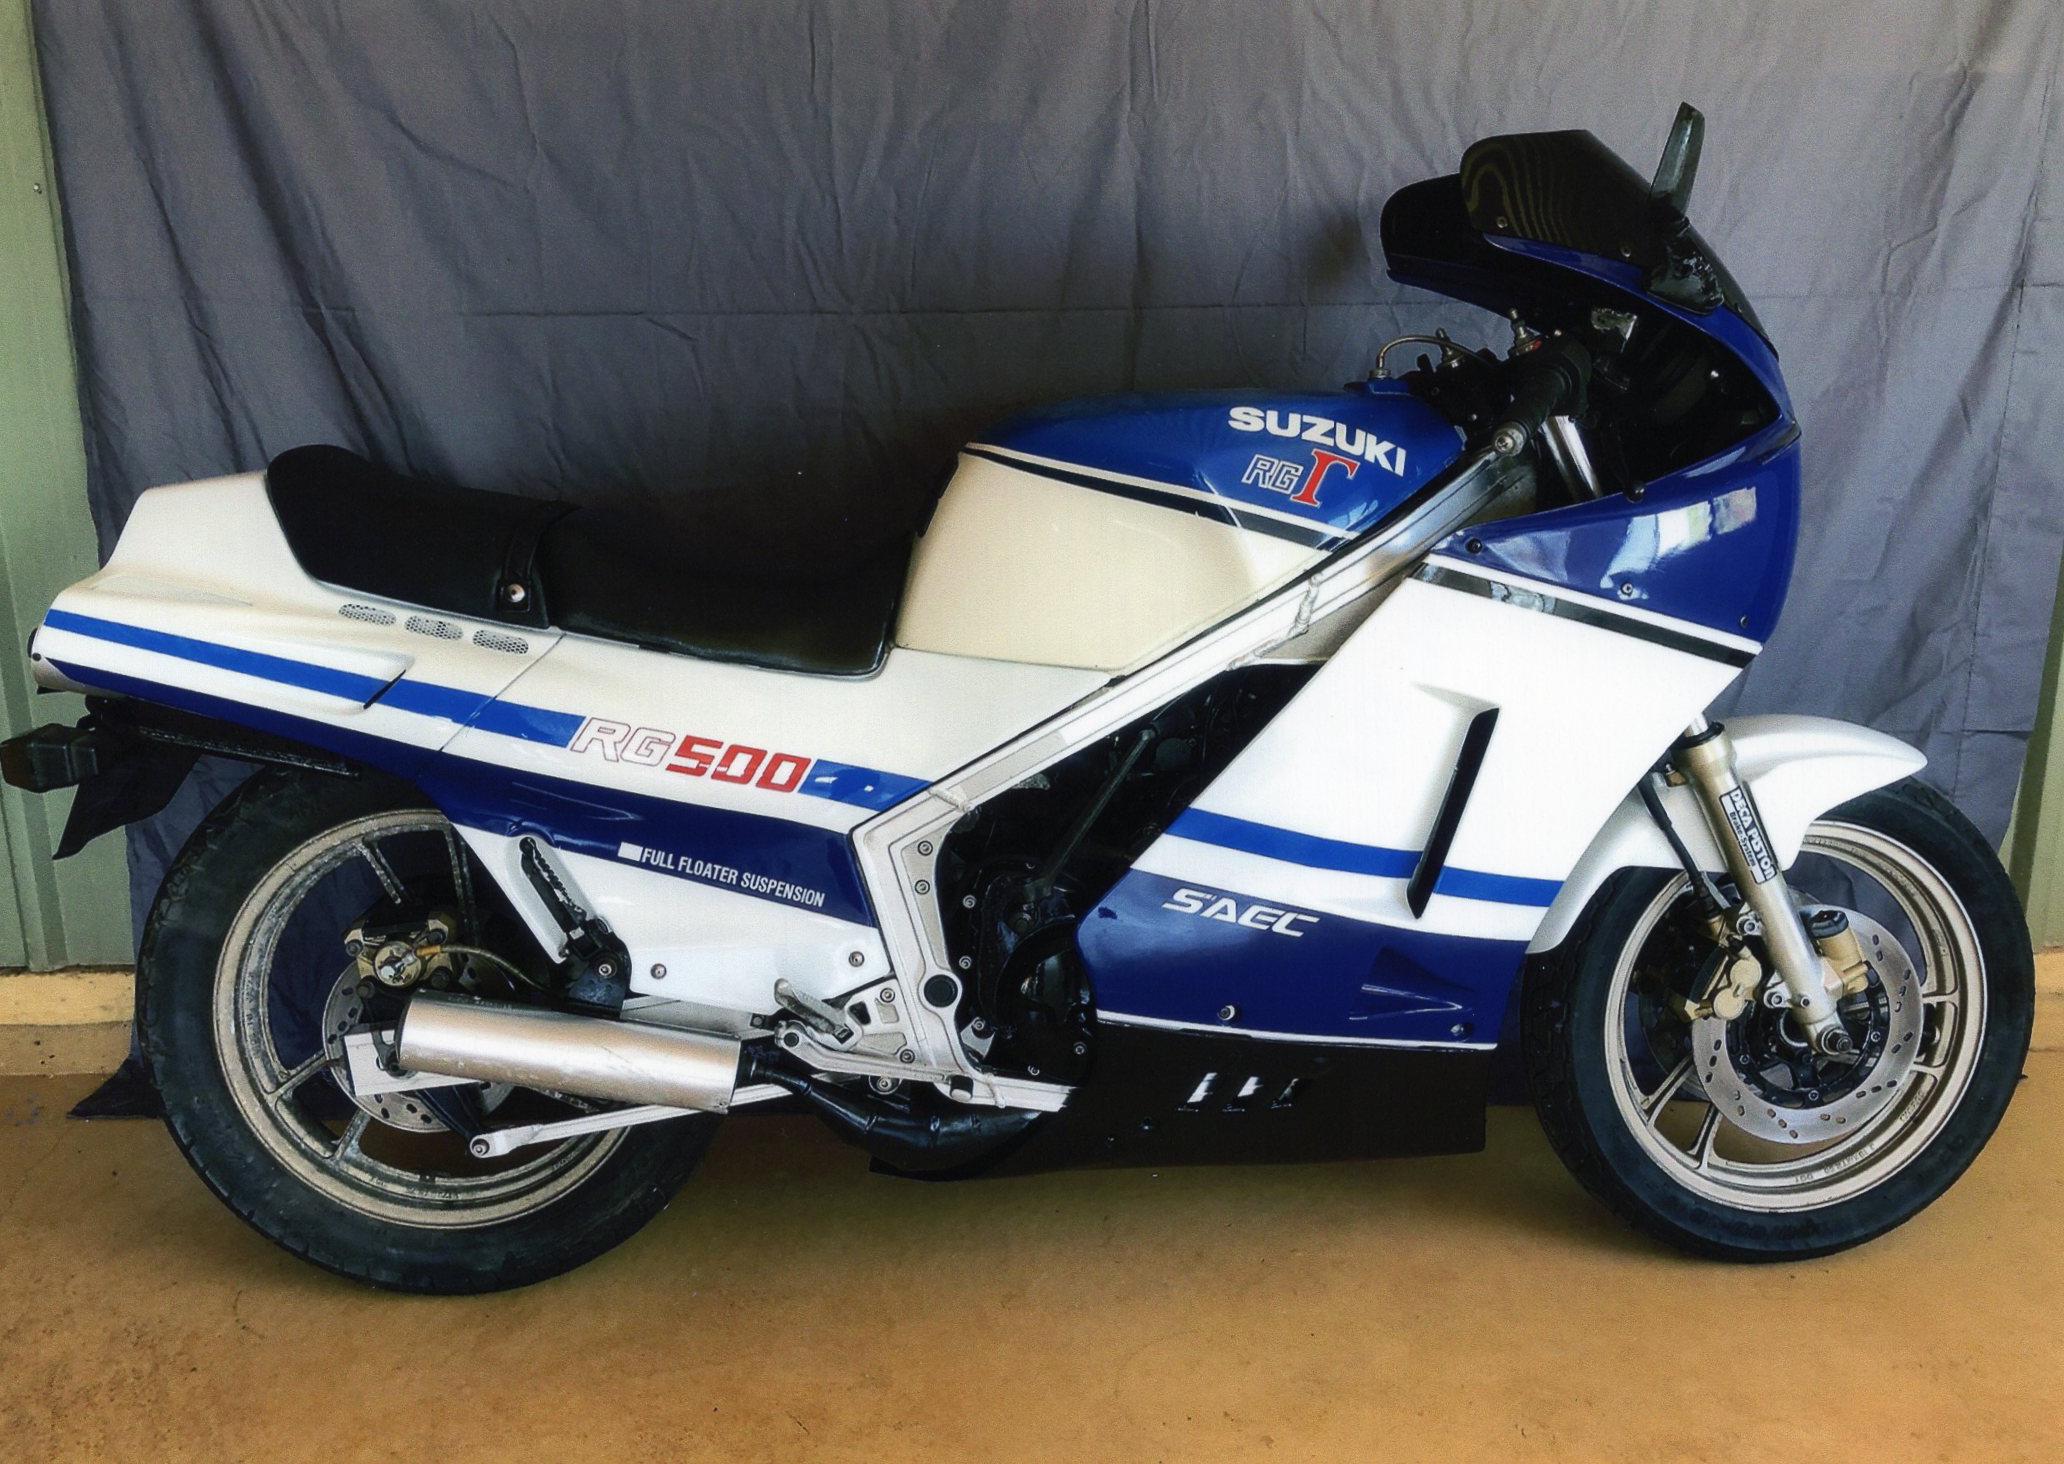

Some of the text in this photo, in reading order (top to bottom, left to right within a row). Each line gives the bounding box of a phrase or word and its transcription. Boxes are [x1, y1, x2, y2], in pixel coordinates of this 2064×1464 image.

[1228, 406, 1407, 477] SUZUKI
[570, 717, 812, 794] RG500
[1729, 788, 1753, 829] DECA
[641, 848, 826, 907] FULL FLOATER SUSPENSION
[1161, 888, 1320, 937] SAEC
